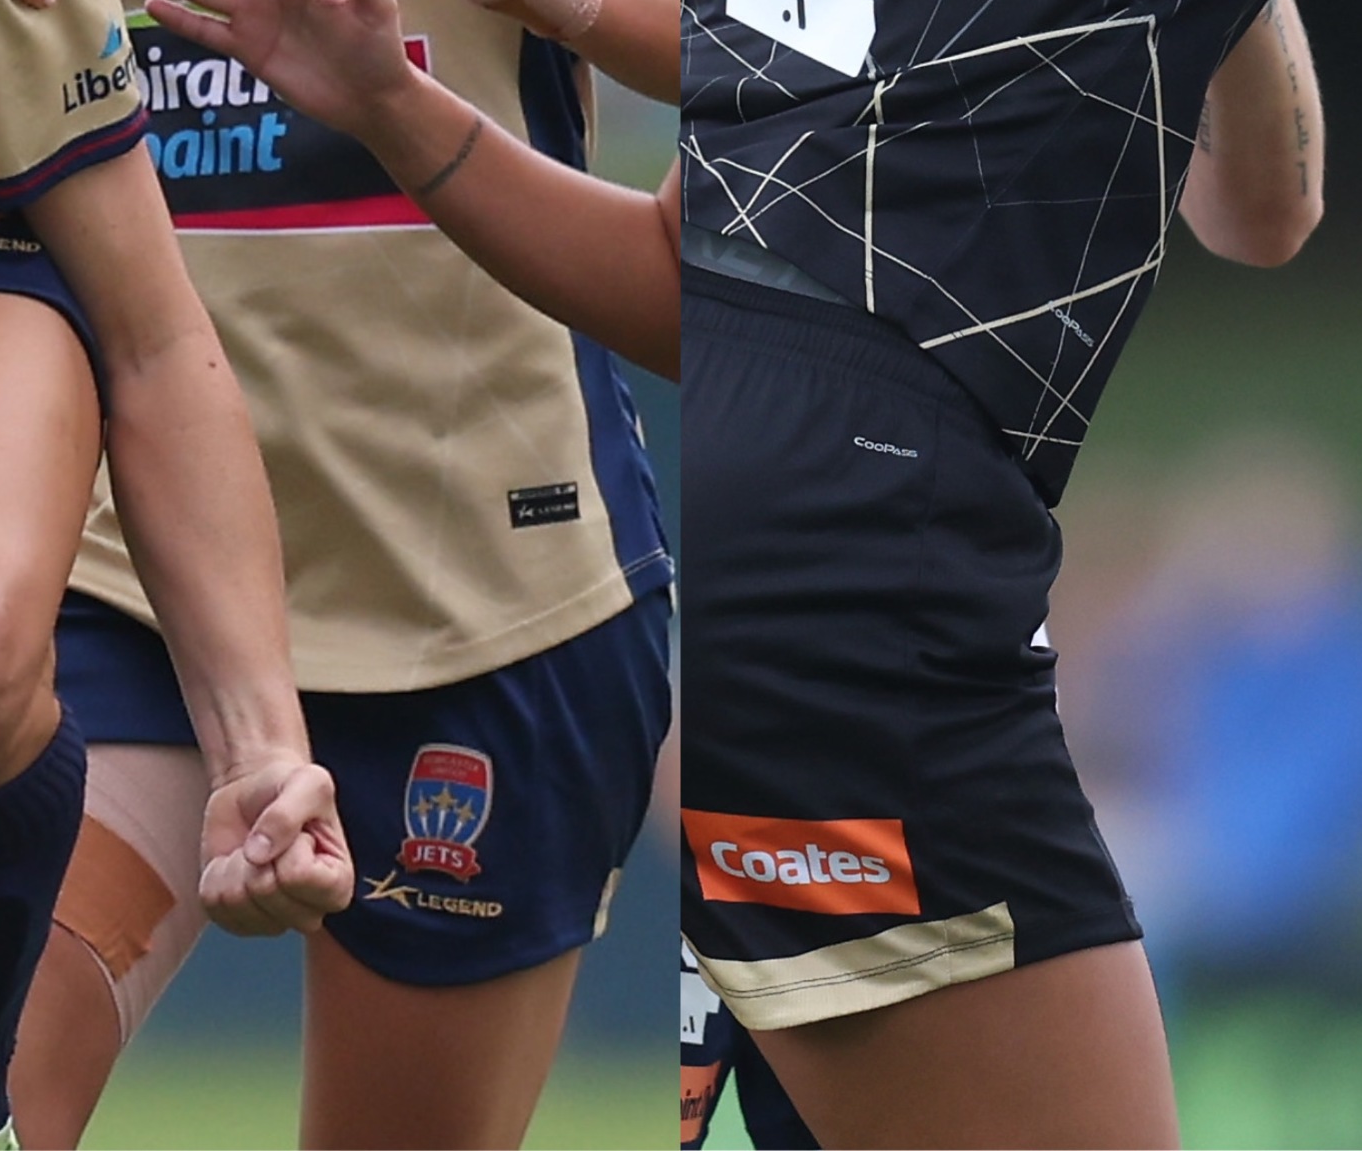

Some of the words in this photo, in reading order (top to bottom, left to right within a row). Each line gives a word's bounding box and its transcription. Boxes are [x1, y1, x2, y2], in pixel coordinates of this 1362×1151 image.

[412, 845, 464, 868] JETS
[710, 841, 891, 885] Coates
[416, 893, 503, 918] LEGEND
